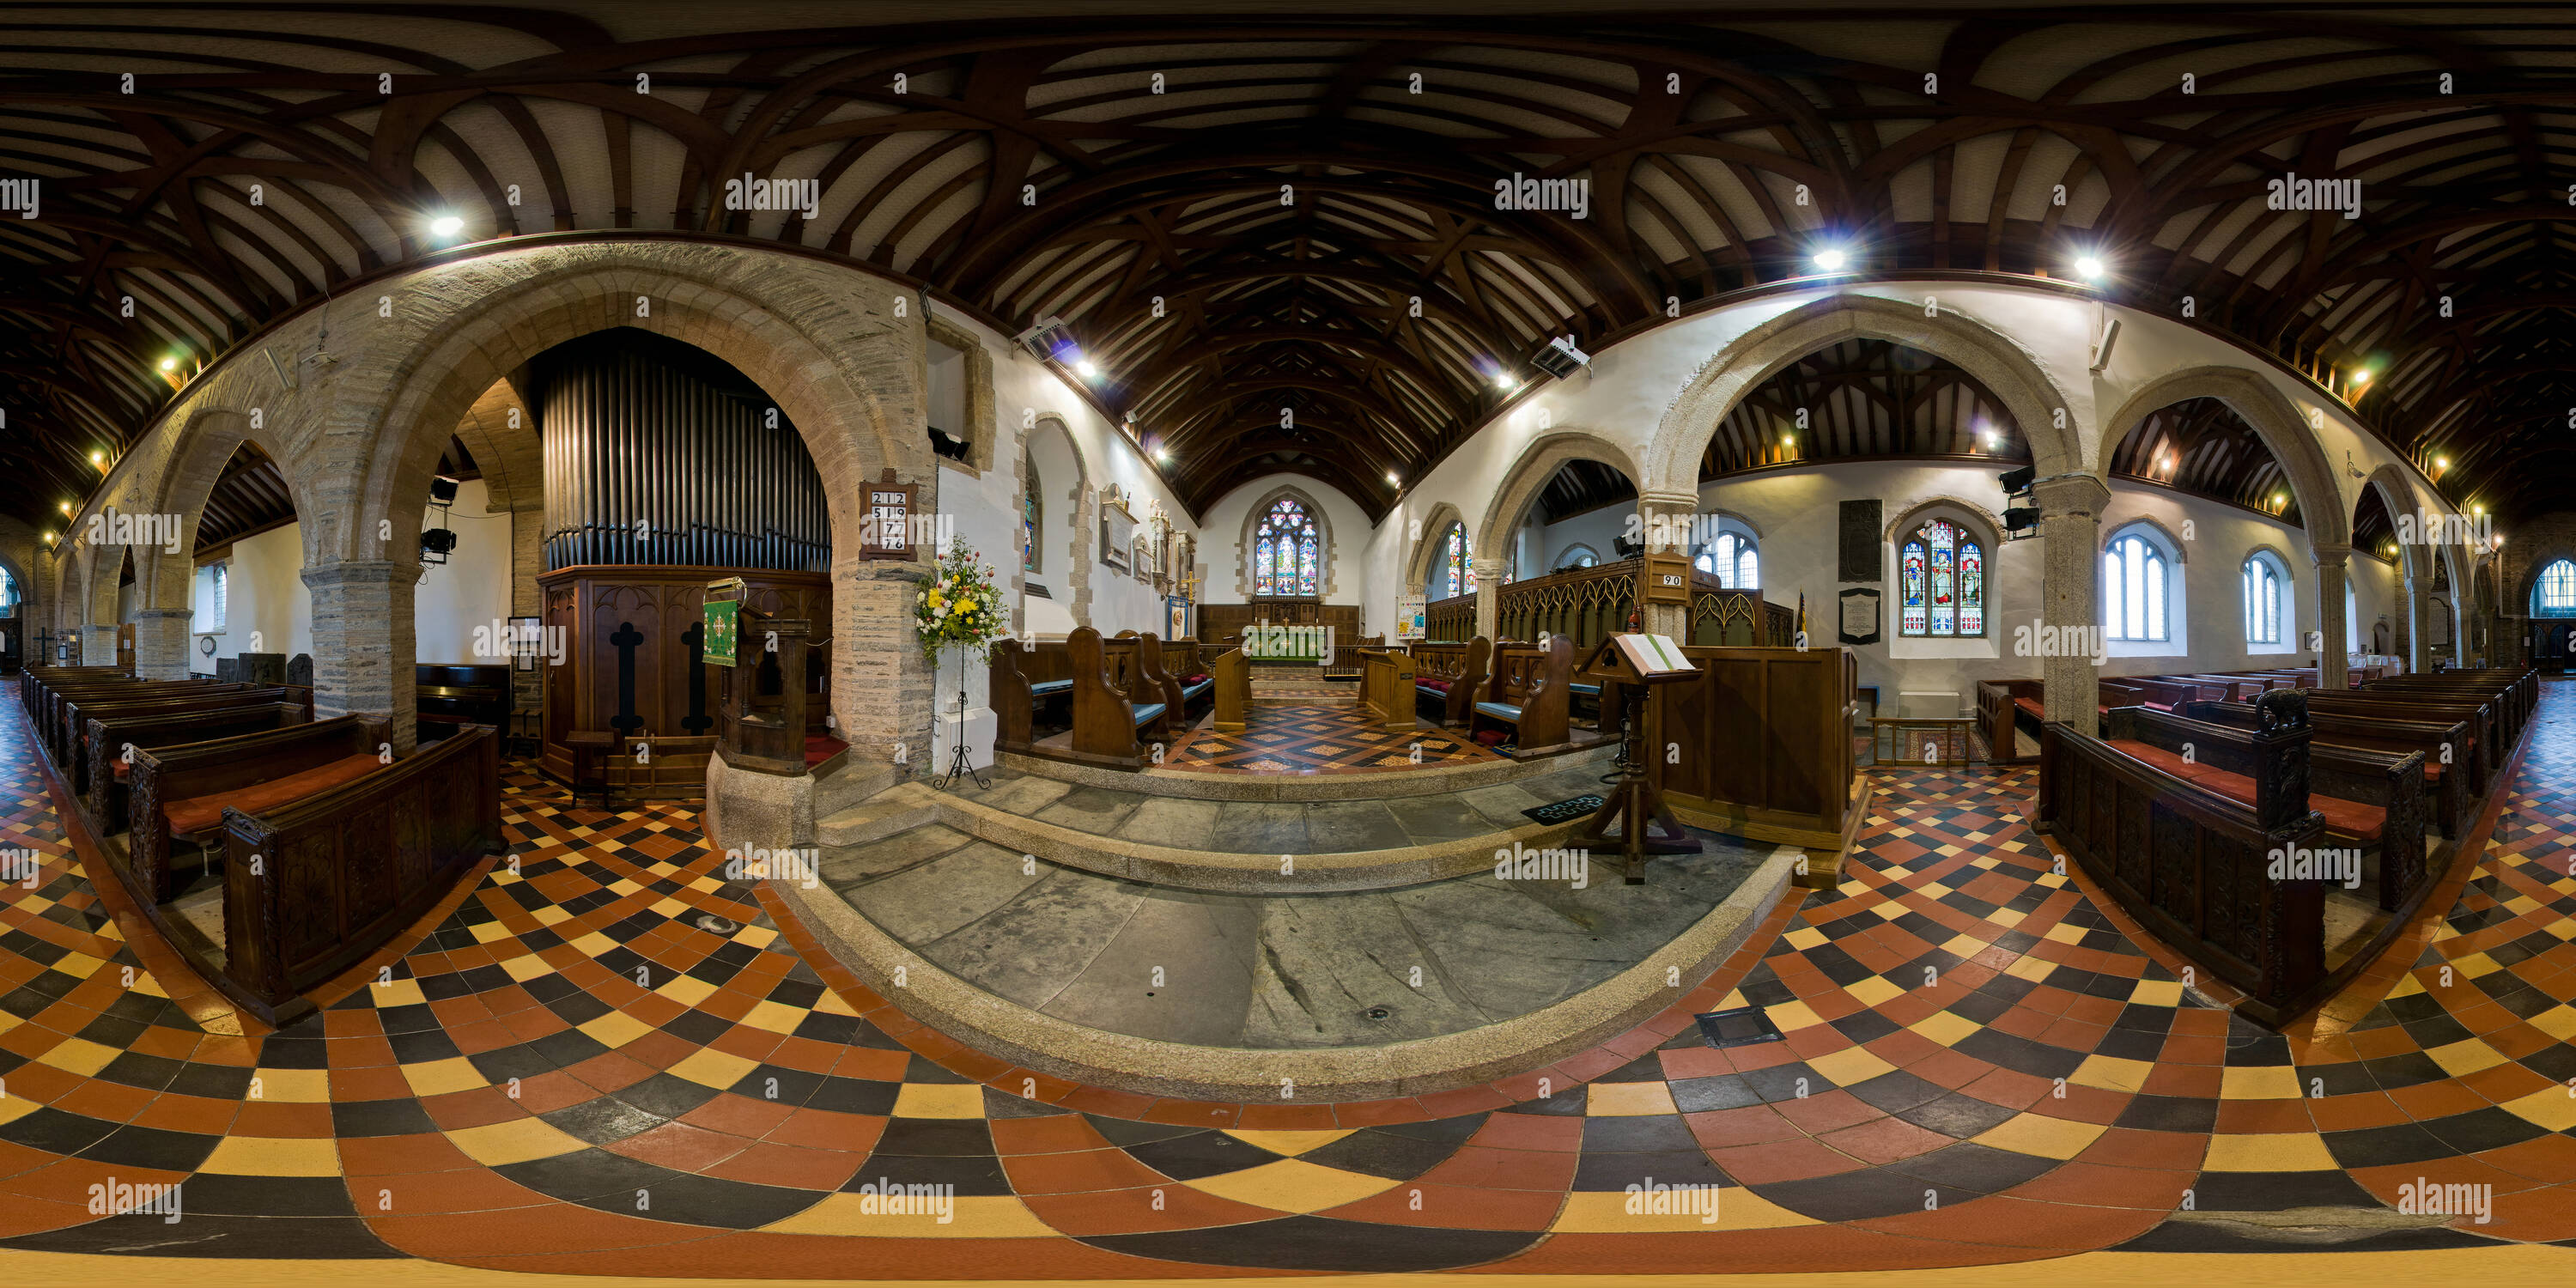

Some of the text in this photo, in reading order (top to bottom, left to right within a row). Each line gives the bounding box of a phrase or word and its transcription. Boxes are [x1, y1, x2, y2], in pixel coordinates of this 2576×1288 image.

[873, 493, 904, 504] 212
[874, 507, 905, 519] 519
[886, 523, 904, 534] 77
[884, 538, 902, 550] 76
[1665, 575, 1680, 586] 90
